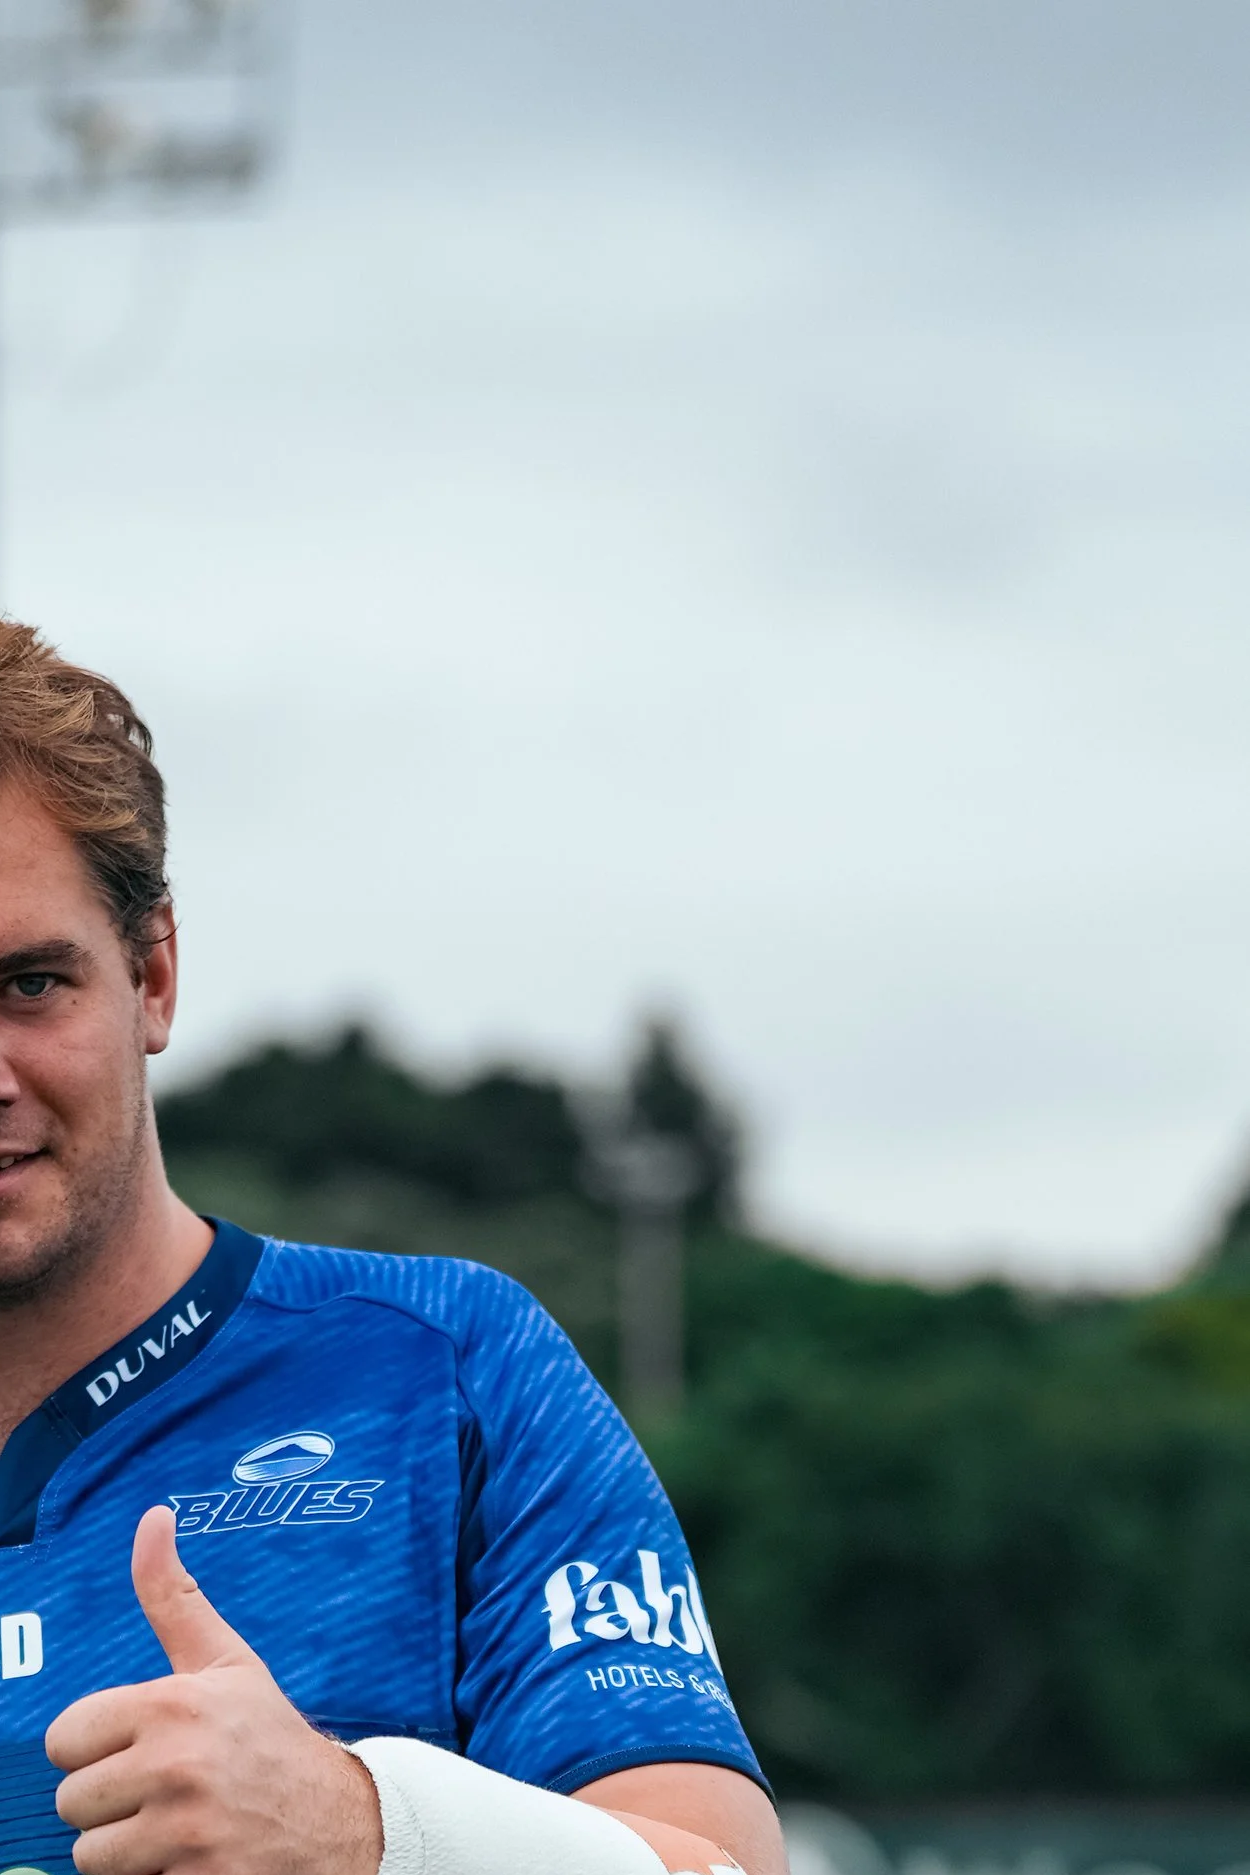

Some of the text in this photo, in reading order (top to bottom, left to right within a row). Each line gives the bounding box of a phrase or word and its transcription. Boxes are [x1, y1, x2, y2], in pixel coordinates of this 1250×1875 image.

[85, 1299, 212, 1407] DUVAL
[168, 1479, 385, 1537] BLUES
[585, 1665, 685, 1692] HOTELS
